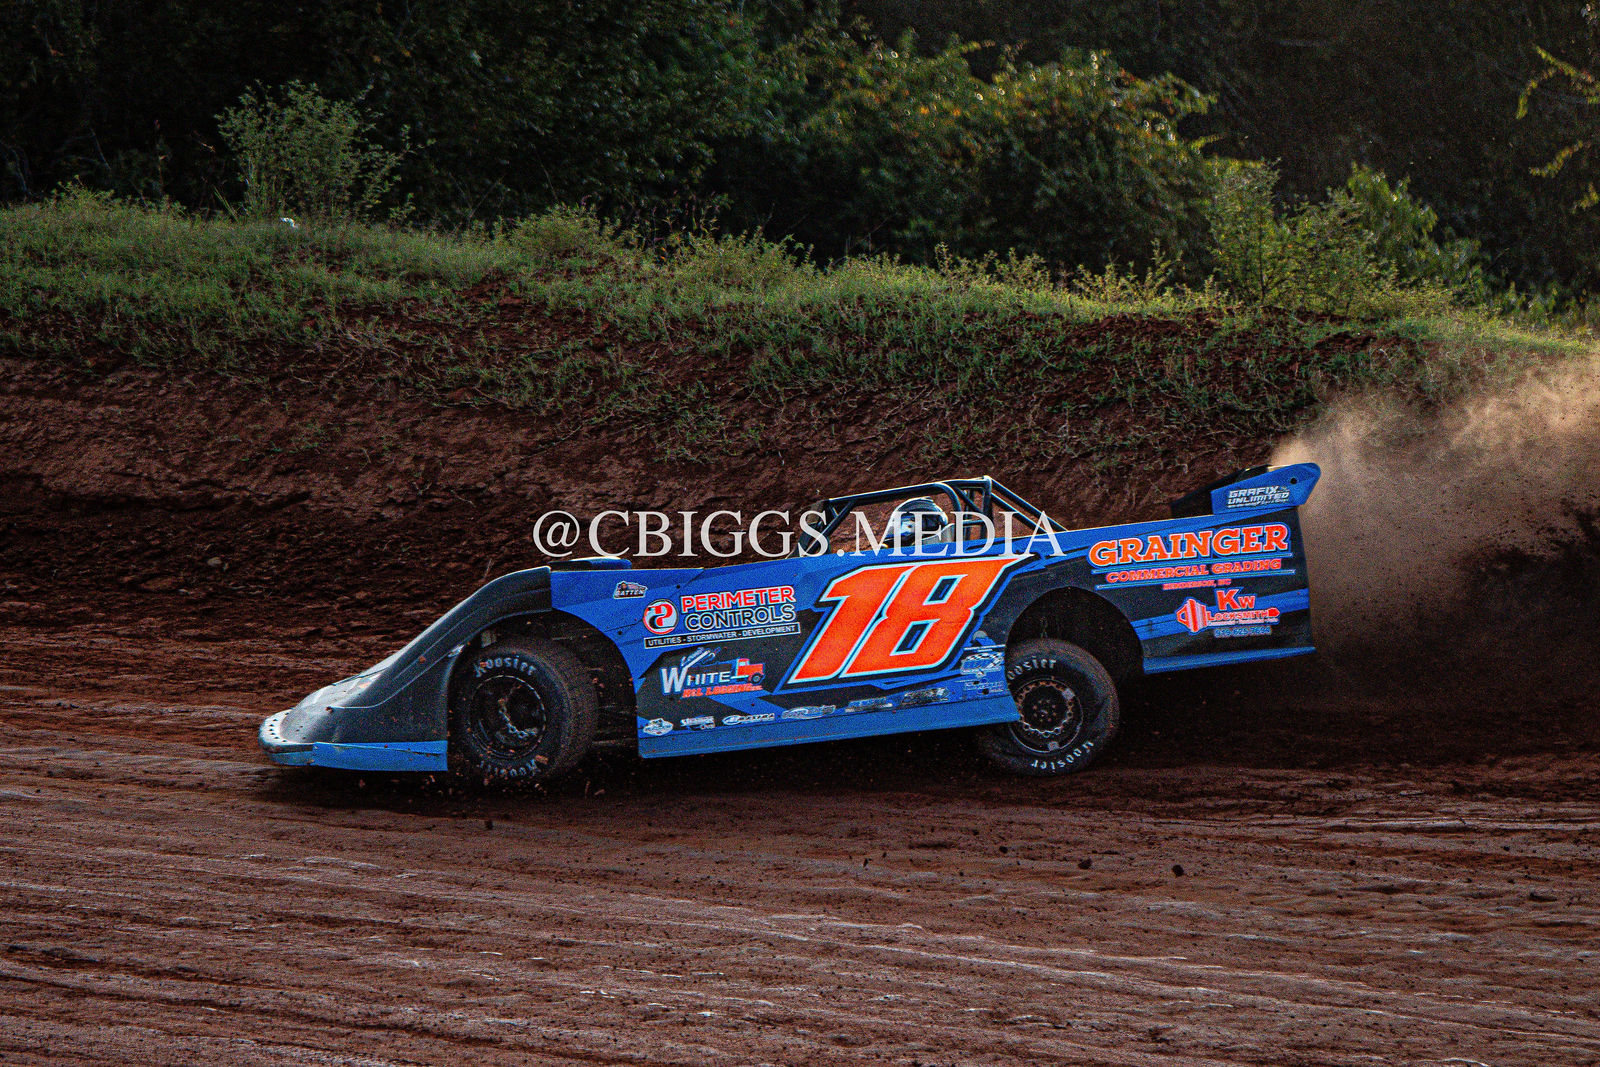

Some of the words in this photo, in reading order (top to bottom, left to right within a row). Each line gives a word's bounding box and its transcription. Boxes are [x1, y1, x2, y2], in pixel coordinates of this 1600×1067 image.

[1228, 486, 1280, 498] GRAFIX
[1228, 492, 1290, 505] UNLIMITED
[1089, 524, 1289, 567] GRAINGER
[1106, 564, 1210, 583] COMMERCIAL
[1212, 558, 1282, 575] GRADING
[681, 585, 797, 614] PERIMETER
[685, 603, 797, 632] CONTROLS
[788, 555, 1033, 684] 18
[1206, 608, 1269, 621] LOCKSMITH
[648, 636, 682, 646] UTILITIES
[687, 631, 737, 643] STORMWATER
[743, 624, 796, 637] DEVELOPMENT
[1007, 655, 1057, 681] oosier
